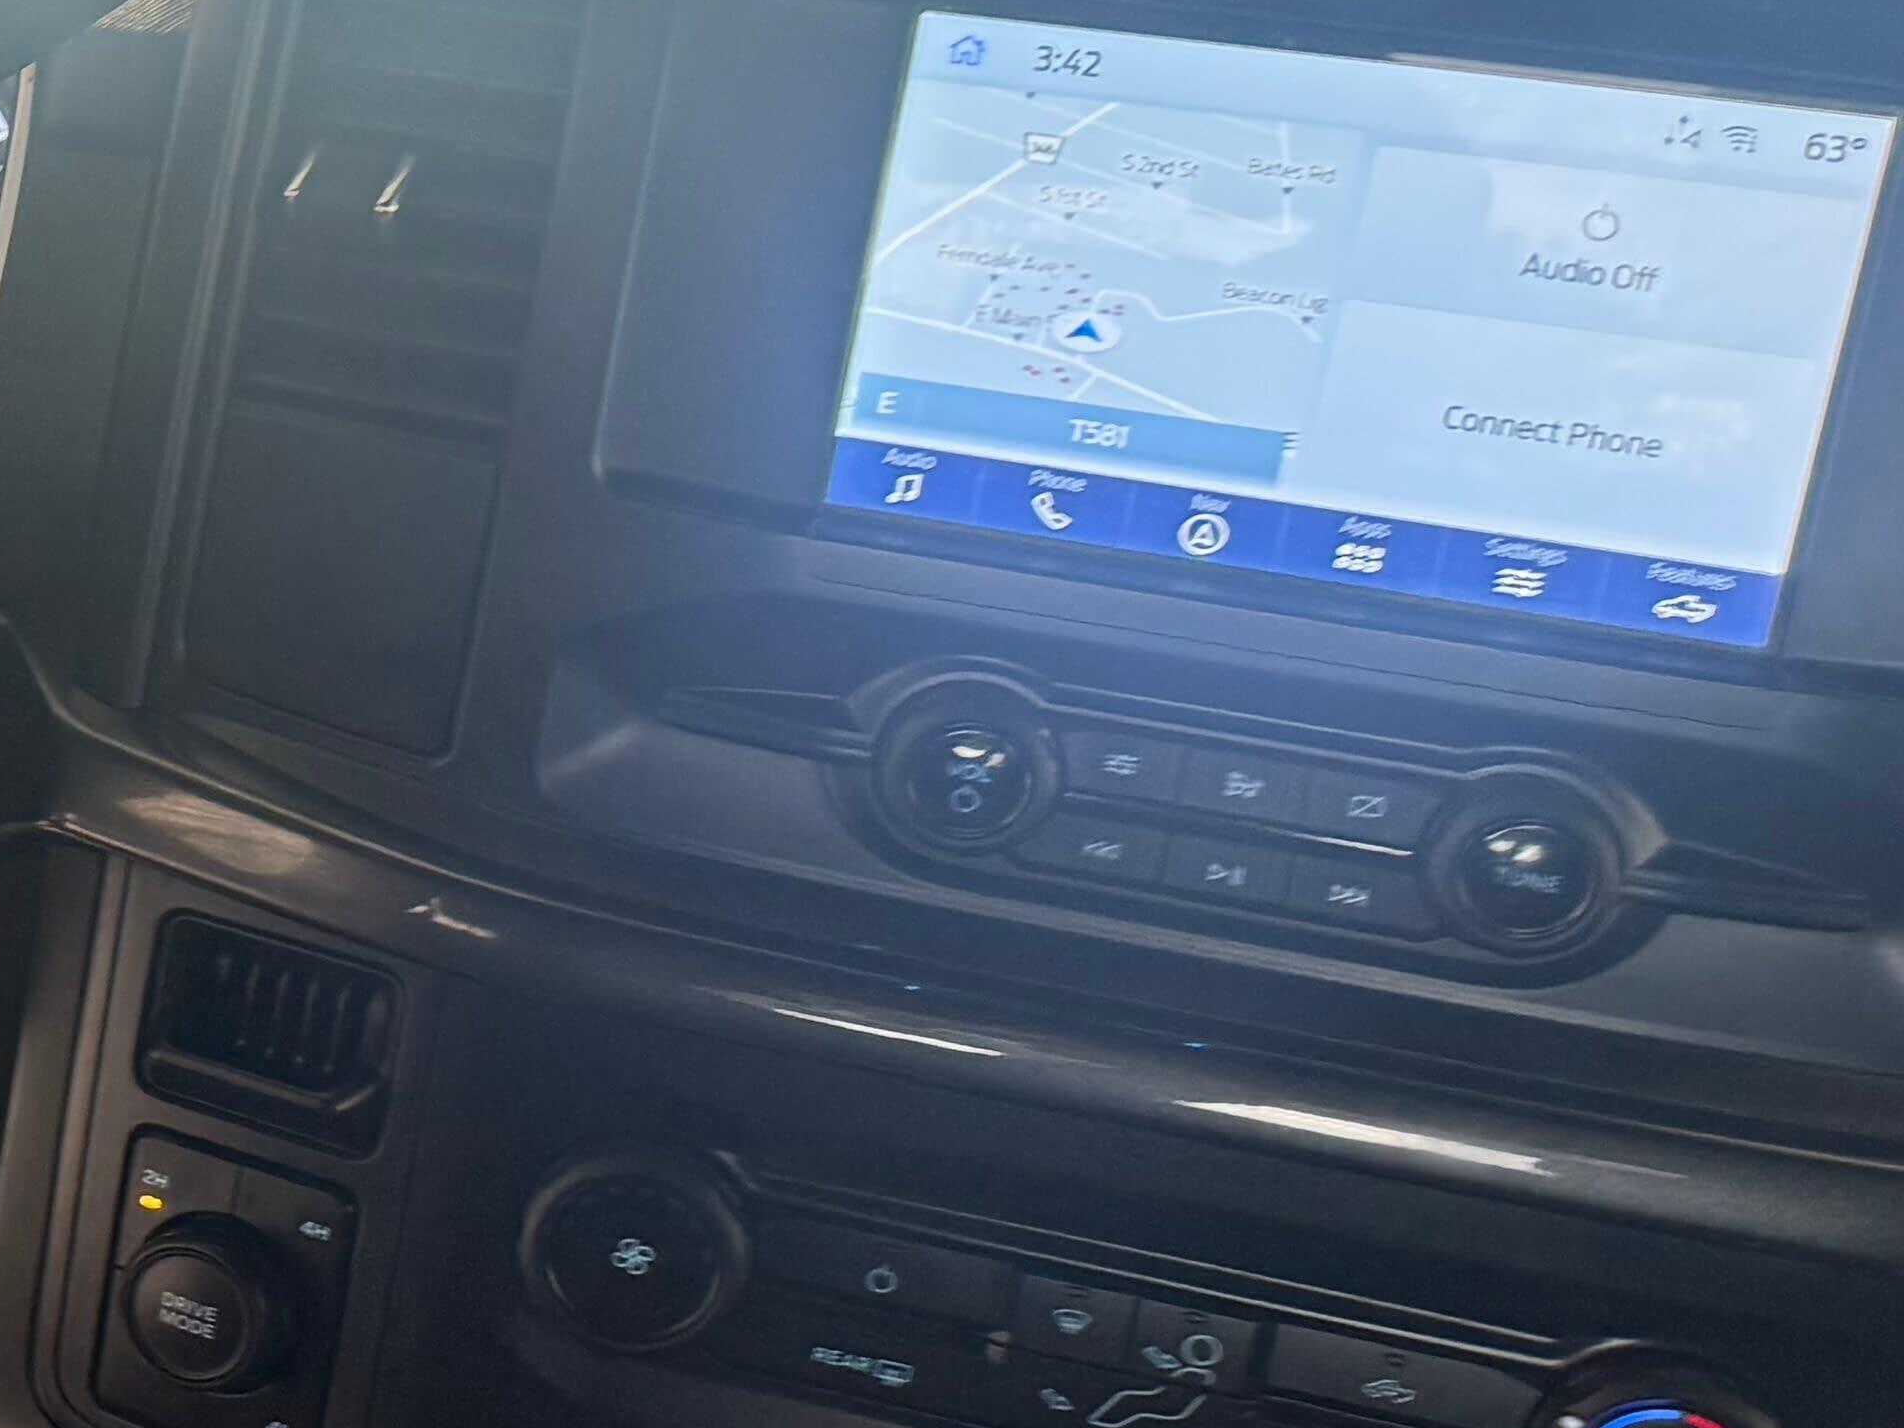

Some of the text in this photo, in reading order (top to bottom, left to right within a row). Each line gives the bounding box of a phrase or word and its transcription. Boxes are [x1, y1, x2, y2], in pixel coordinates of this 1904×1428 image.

[1033, 44, 1104, 78] 3:42
[1519, 253, 1661, 293] Audio Off
[1442, 404, 1664, 458] Connect Phone
[161, 1290, 220, 1323] DRIVE
[158, 1308, 218, 1341] MODE
